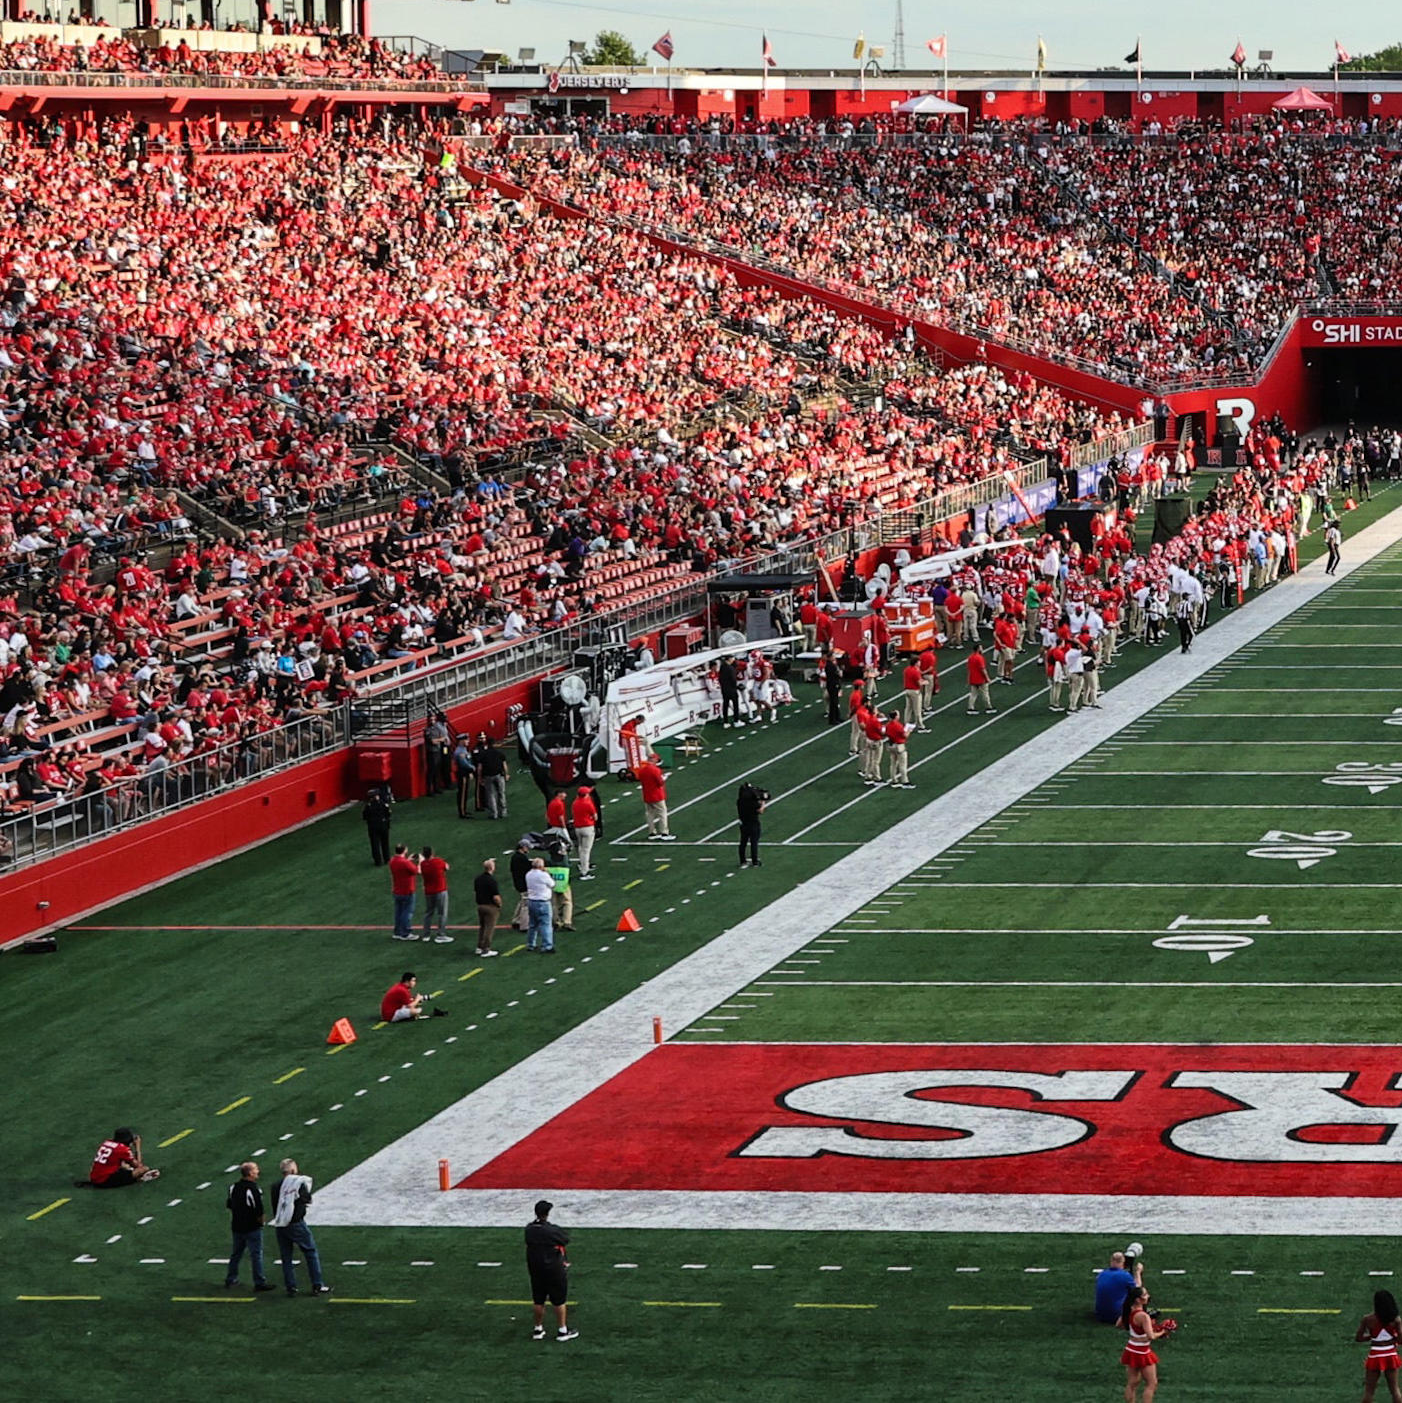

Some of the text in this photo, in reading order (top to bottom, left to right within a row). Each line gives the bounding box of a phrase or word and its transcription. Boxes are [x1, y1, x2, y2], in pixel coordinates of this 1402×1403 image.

[1323, 324, 1360, 342] SHI
[1245, 830, 1353, 860] 20
[1151, 915, 1272, 951] 10
